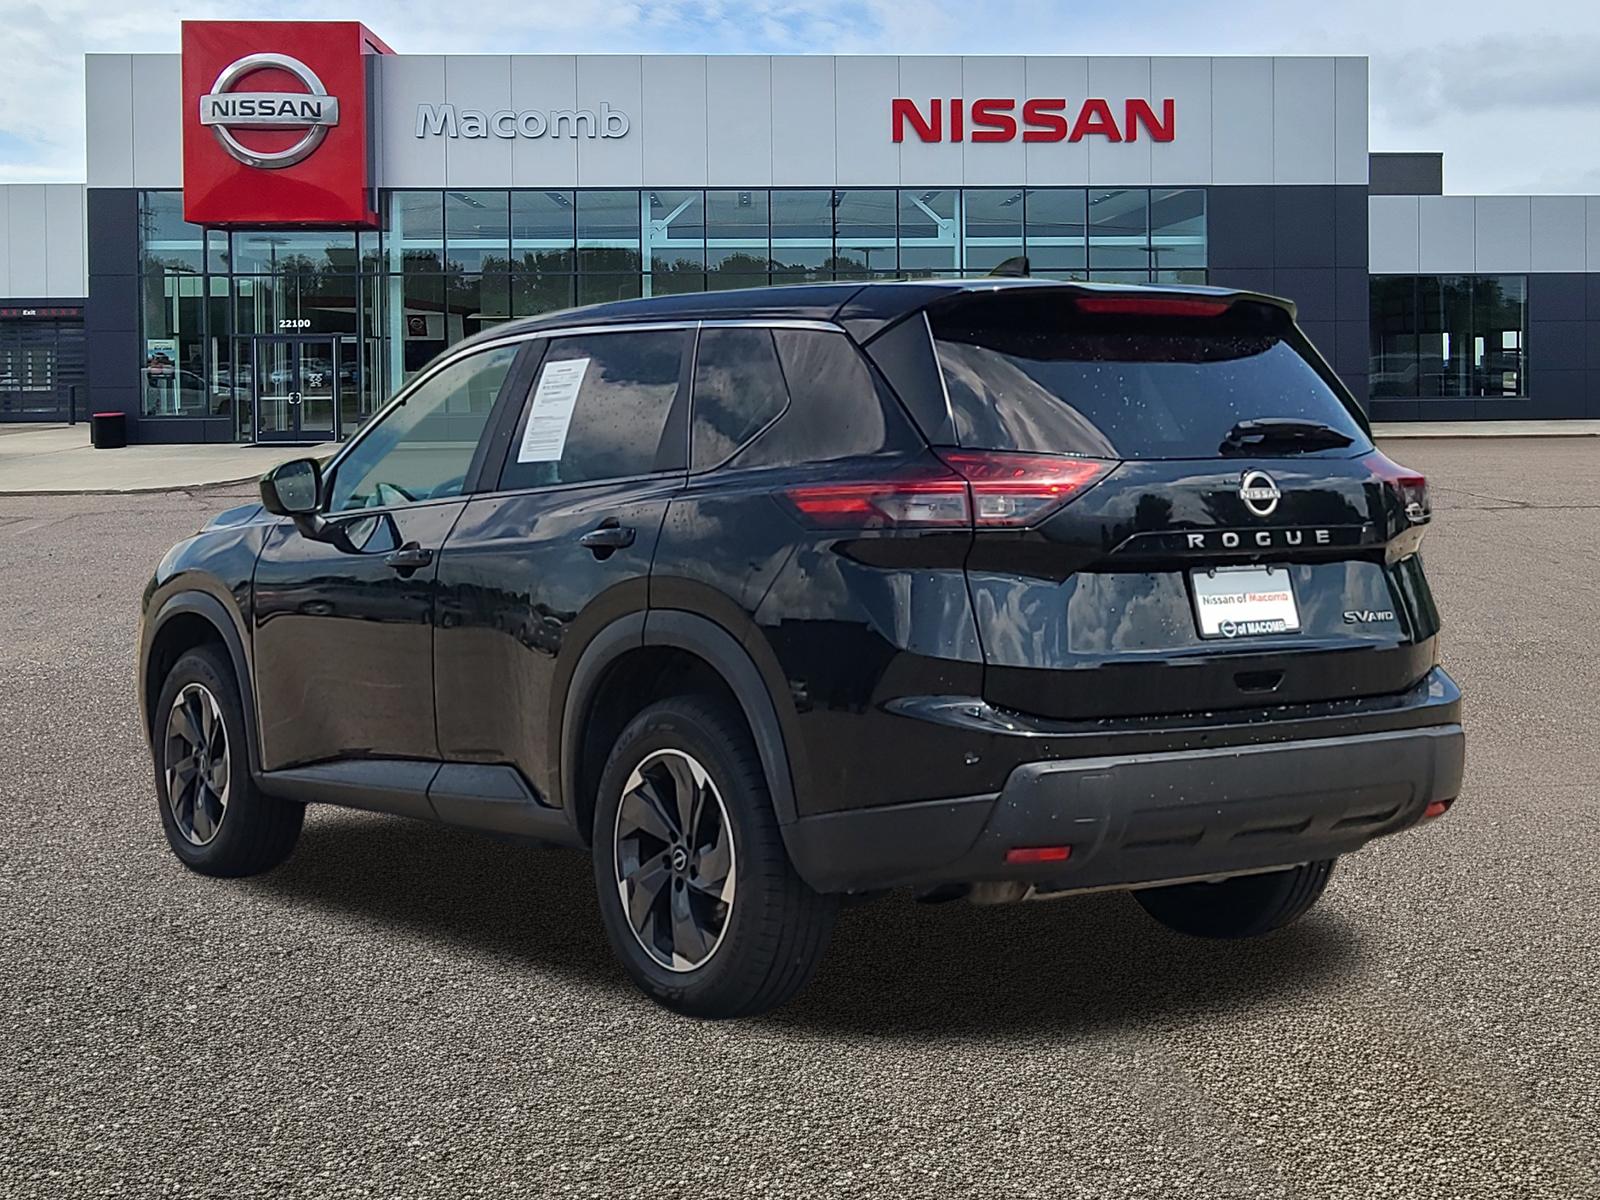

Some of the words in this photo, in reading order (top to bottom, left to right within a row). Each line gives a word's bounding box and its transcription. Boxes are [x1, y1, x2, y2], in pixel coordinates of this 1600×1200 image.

[212, 101, 322, 117] NISSAN
[416, 102, 630, 139] Macomb
[892, 98, 1175, 143] NISSAN
[279, 319, 311, 328] 22100
[1241, 489, 1280, 499] NISSAN
[1187, 529, 1330, 548] ROGUE
[1202, 594, 1236, 606] Nissan
[1236, 593, 1247, 604] of
[1248, 592, 1289, 603] Macomb
[1246, 620, 1287, 634] MACOMB
